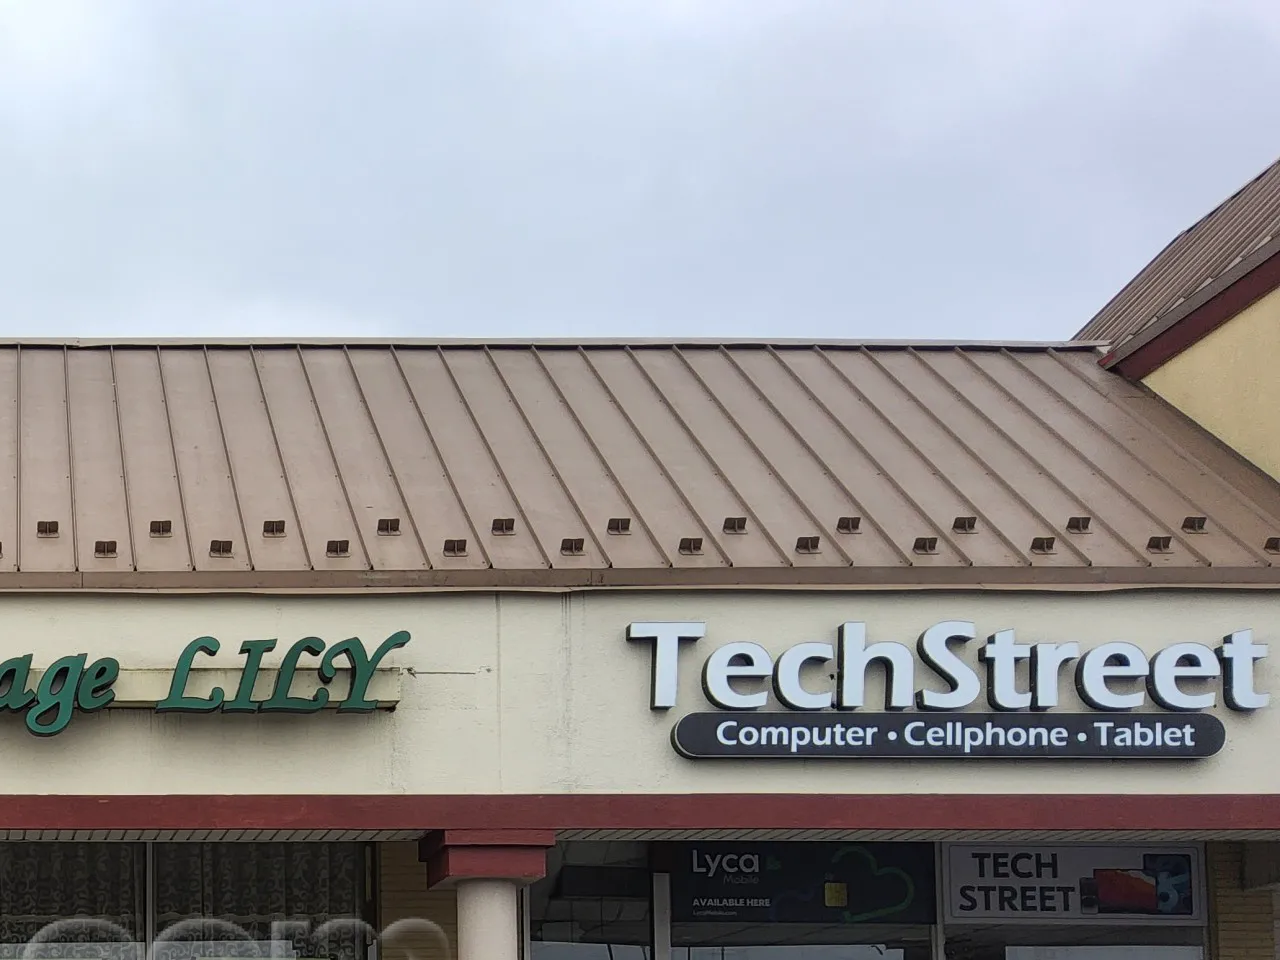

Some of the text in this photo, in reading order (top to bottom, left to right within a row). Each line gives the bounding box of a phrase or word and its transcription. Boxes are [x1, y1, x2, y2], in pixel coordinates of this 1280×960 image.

[155, 630, 410, 714] LILY
[627, 620, 1269, 711] TechStreet
[716, 720, 1195, 752] Computer Cellphone Tablet
[692, 849, 760, 877] Lyca
[972, 853, 1059, 878] TECH
[692, 898, 771, 907] AVAILABLE HERE
[959, 885, 1075, 912] STREET
